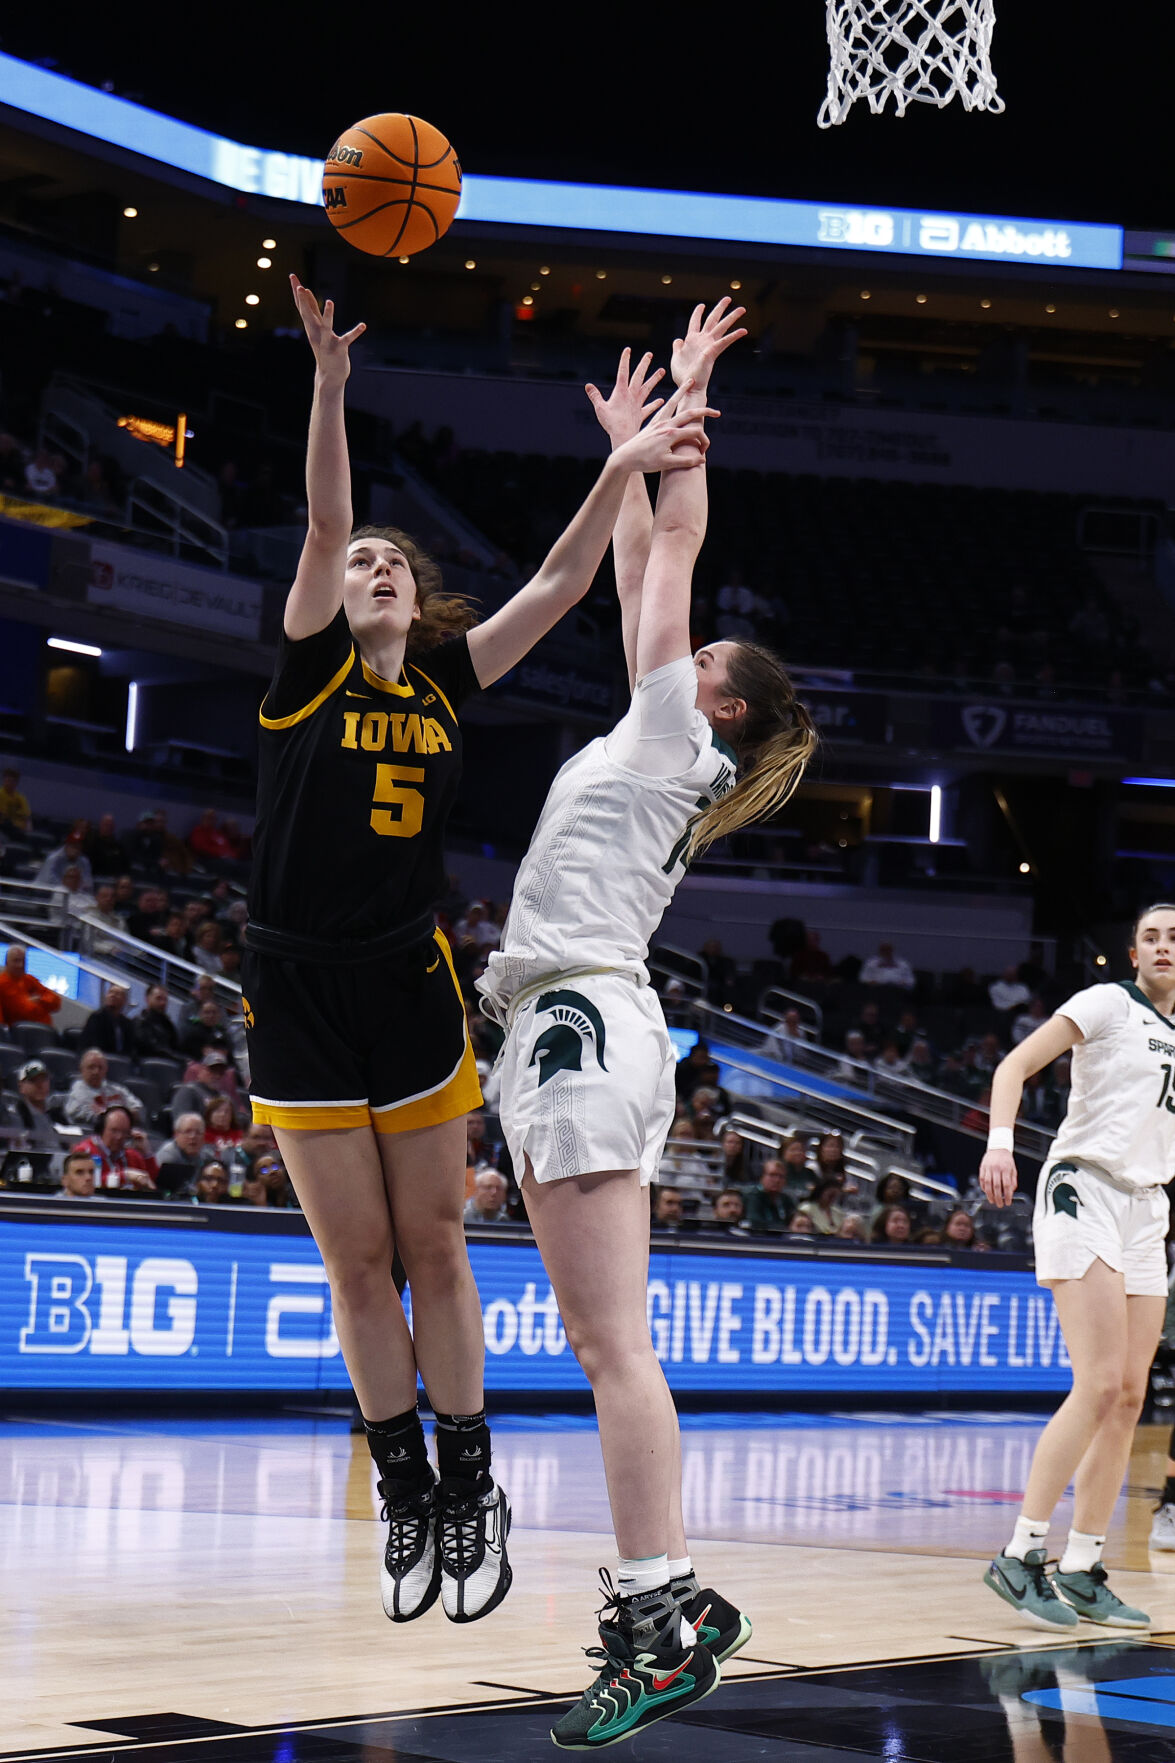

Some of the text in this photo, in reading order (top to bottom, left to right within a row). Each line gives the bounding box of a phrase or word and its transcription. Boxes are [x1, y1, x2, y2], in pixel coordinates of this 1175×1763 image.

[263, 151, 325, 207] GIV
[324, 186, 348, 210] AA
[960, 223, 1072, 258] Abbott
[341, 711, 453, 755] IOWA
[369, 762, 425, 838] 5
[483, 1281, 567, 1356] ott
[647, 1279, 743, 1364] GIVE
[751, 1283, 899, 1366] BLOOD.
[907, 1290, 1000, 1367] SAVE
